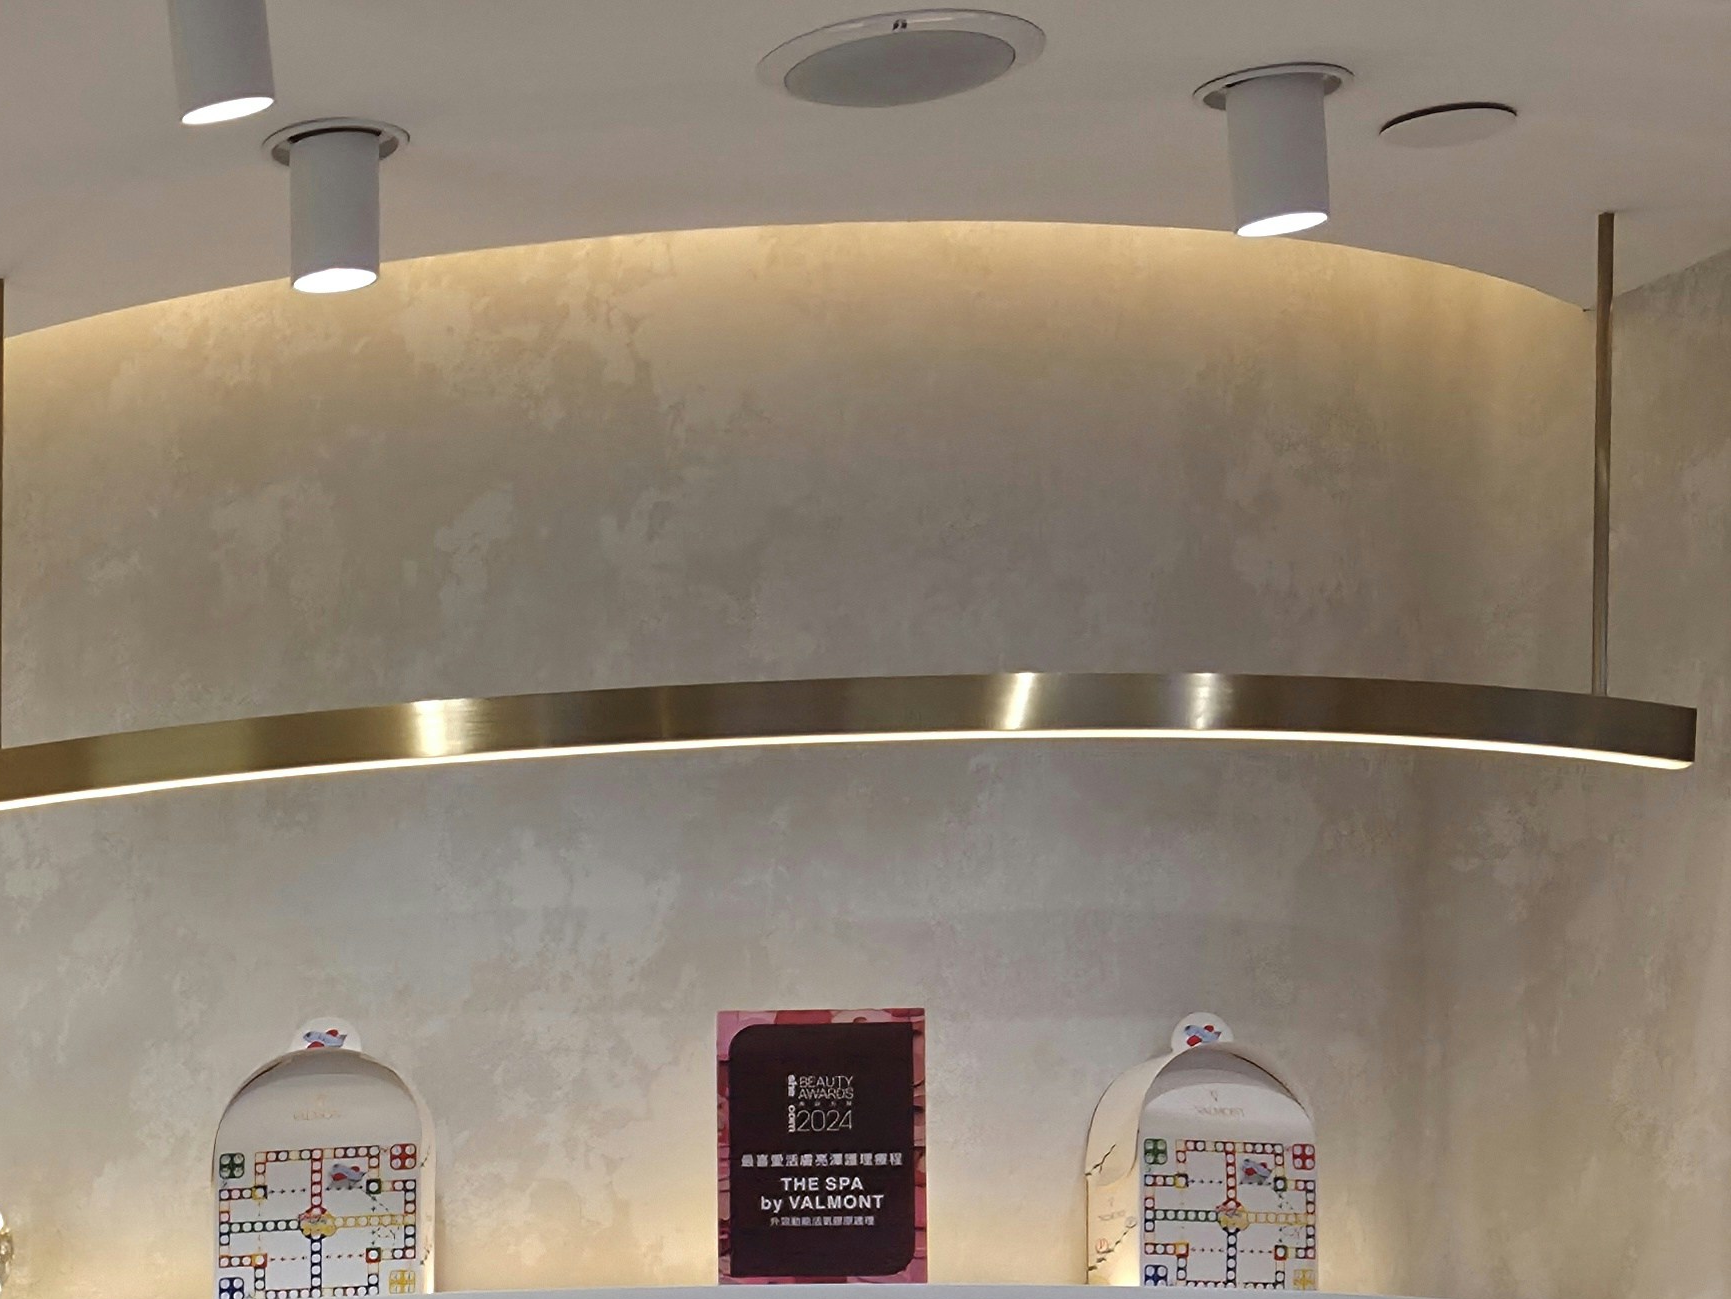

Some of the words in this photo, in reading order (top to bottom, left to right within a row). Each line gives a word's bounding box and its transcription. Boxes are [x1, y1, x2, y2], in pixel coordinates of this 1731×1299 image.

[799, 1075, 854, 1088] BEAUTY
[798, 1088, 855, 1100] AWARDS
[797, 1110, 853, 1132] 2024
[781, 1177, 819, 1191] THE
[825, 1177, 865, 1191] SPA
[761, 1196, 782, 1213] by
[789, 1194, 885, 1210] VALMONT
